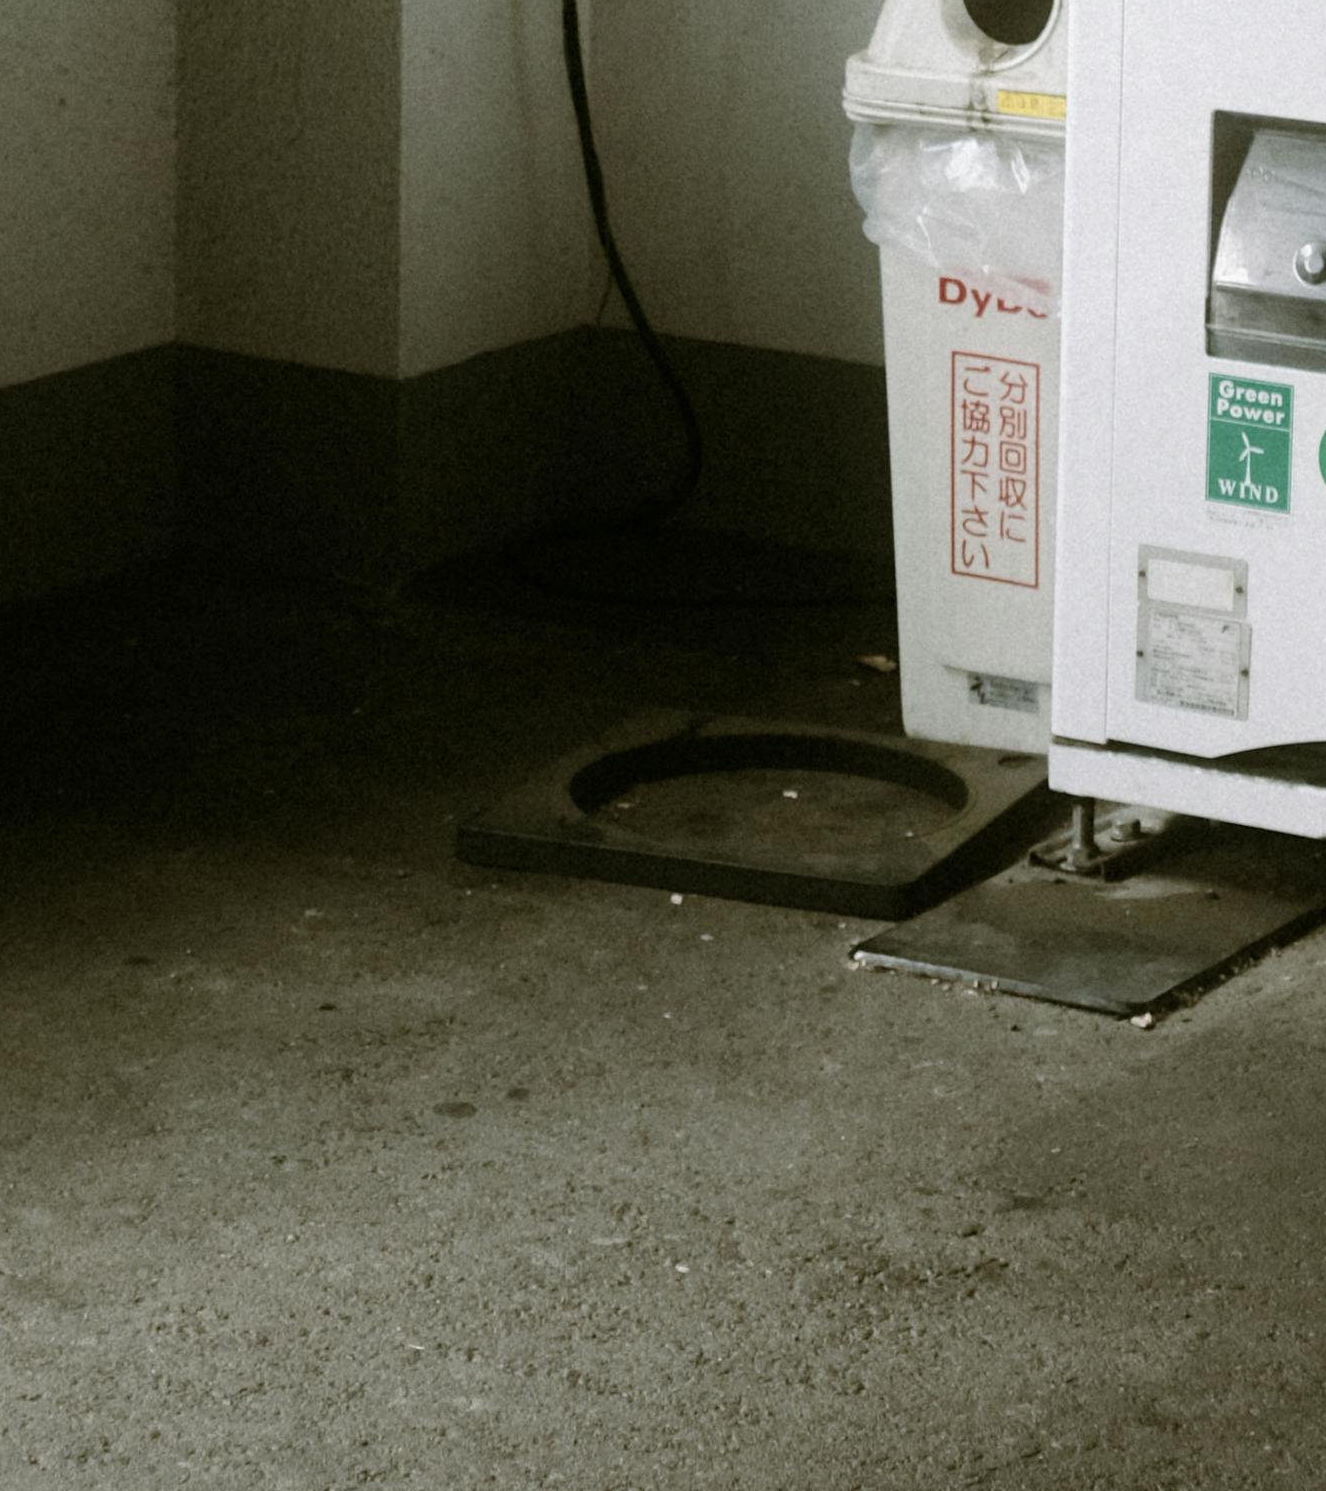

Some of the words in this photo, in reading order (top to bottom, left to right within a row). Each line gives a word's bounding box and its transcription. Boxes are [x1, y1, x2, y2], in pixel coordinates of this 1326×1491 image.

[1218, 380, 1284, 407] Green
[1216, 398, 1286, 426] Power
[960, 364, 991, 570] ご協力下さい
[998, 370, 1029, 544] 分別回収に
[1218, 477, 1279, 505] WIND
